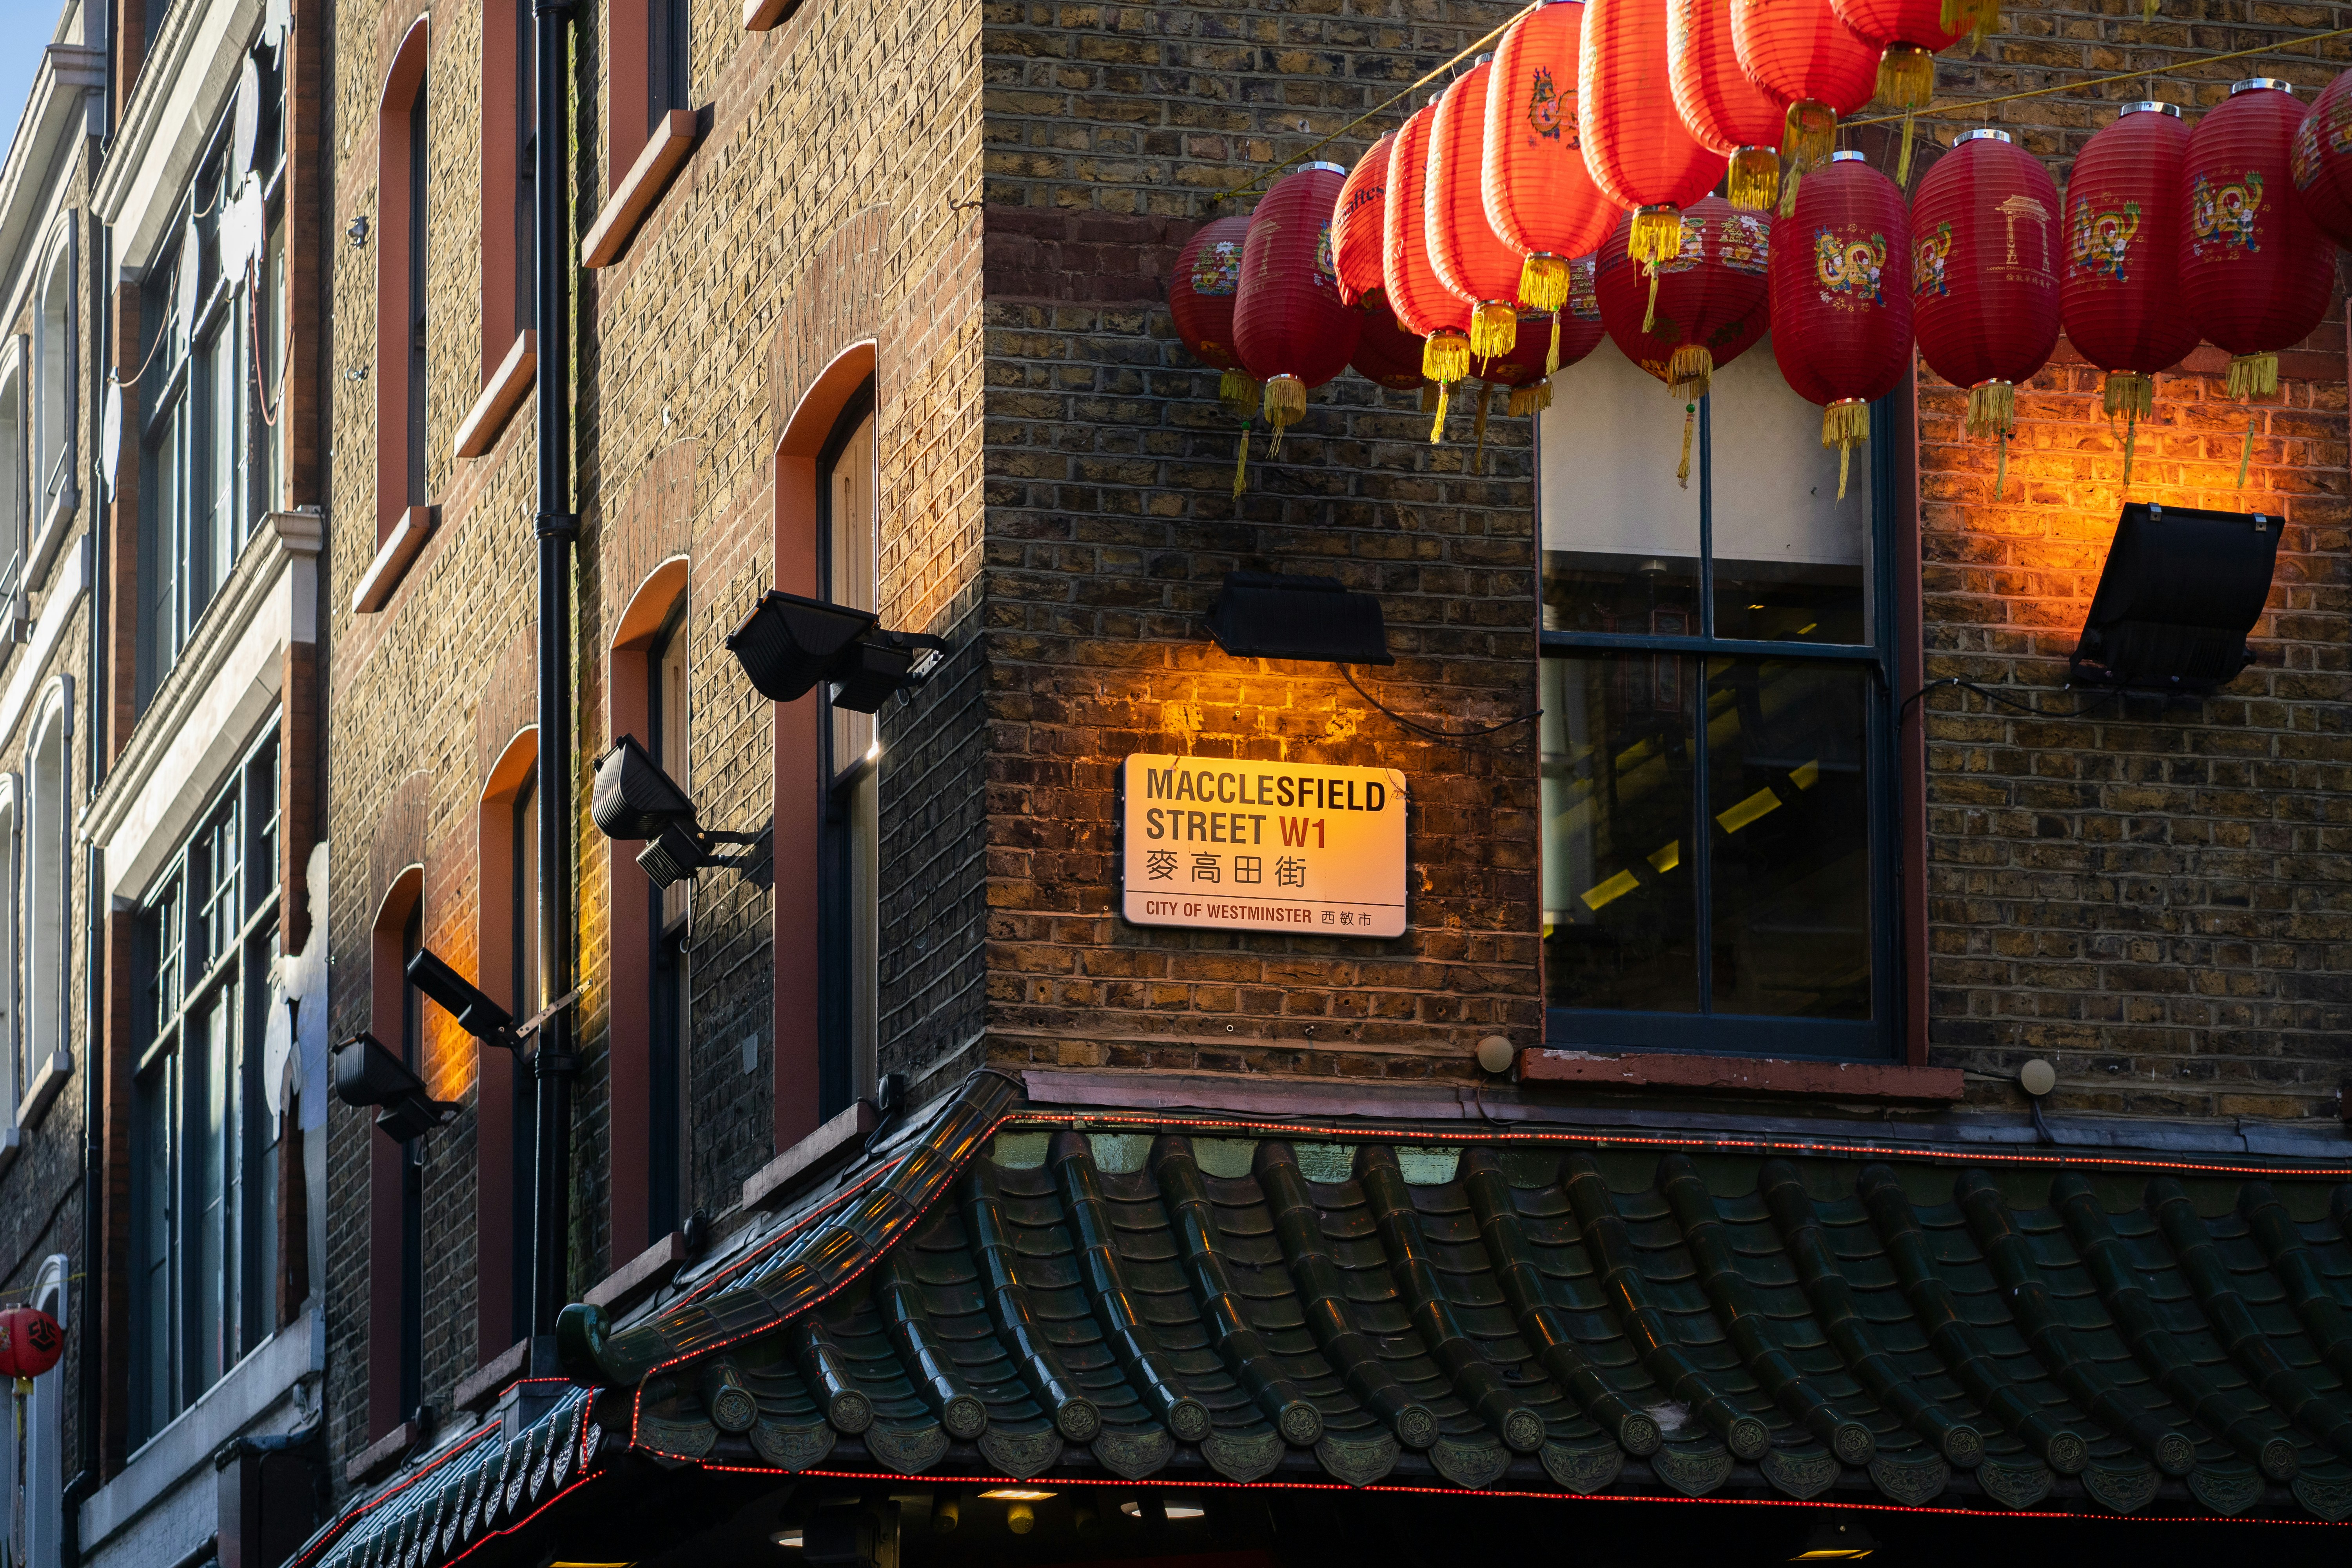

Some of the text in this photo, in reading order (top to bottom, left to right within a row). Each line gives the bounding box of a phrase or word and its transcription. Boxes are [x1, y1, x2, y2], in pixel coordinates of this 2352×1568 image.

[1147, 768, 1385, 811] MACCLESFIELD
[1146, 808, 1325, 848] STREET W1
[1146, 849, 1307, 888] 麥高田街
[1146, 900, 1372, 926] CITY OF WESTMINSTER 西敏市
